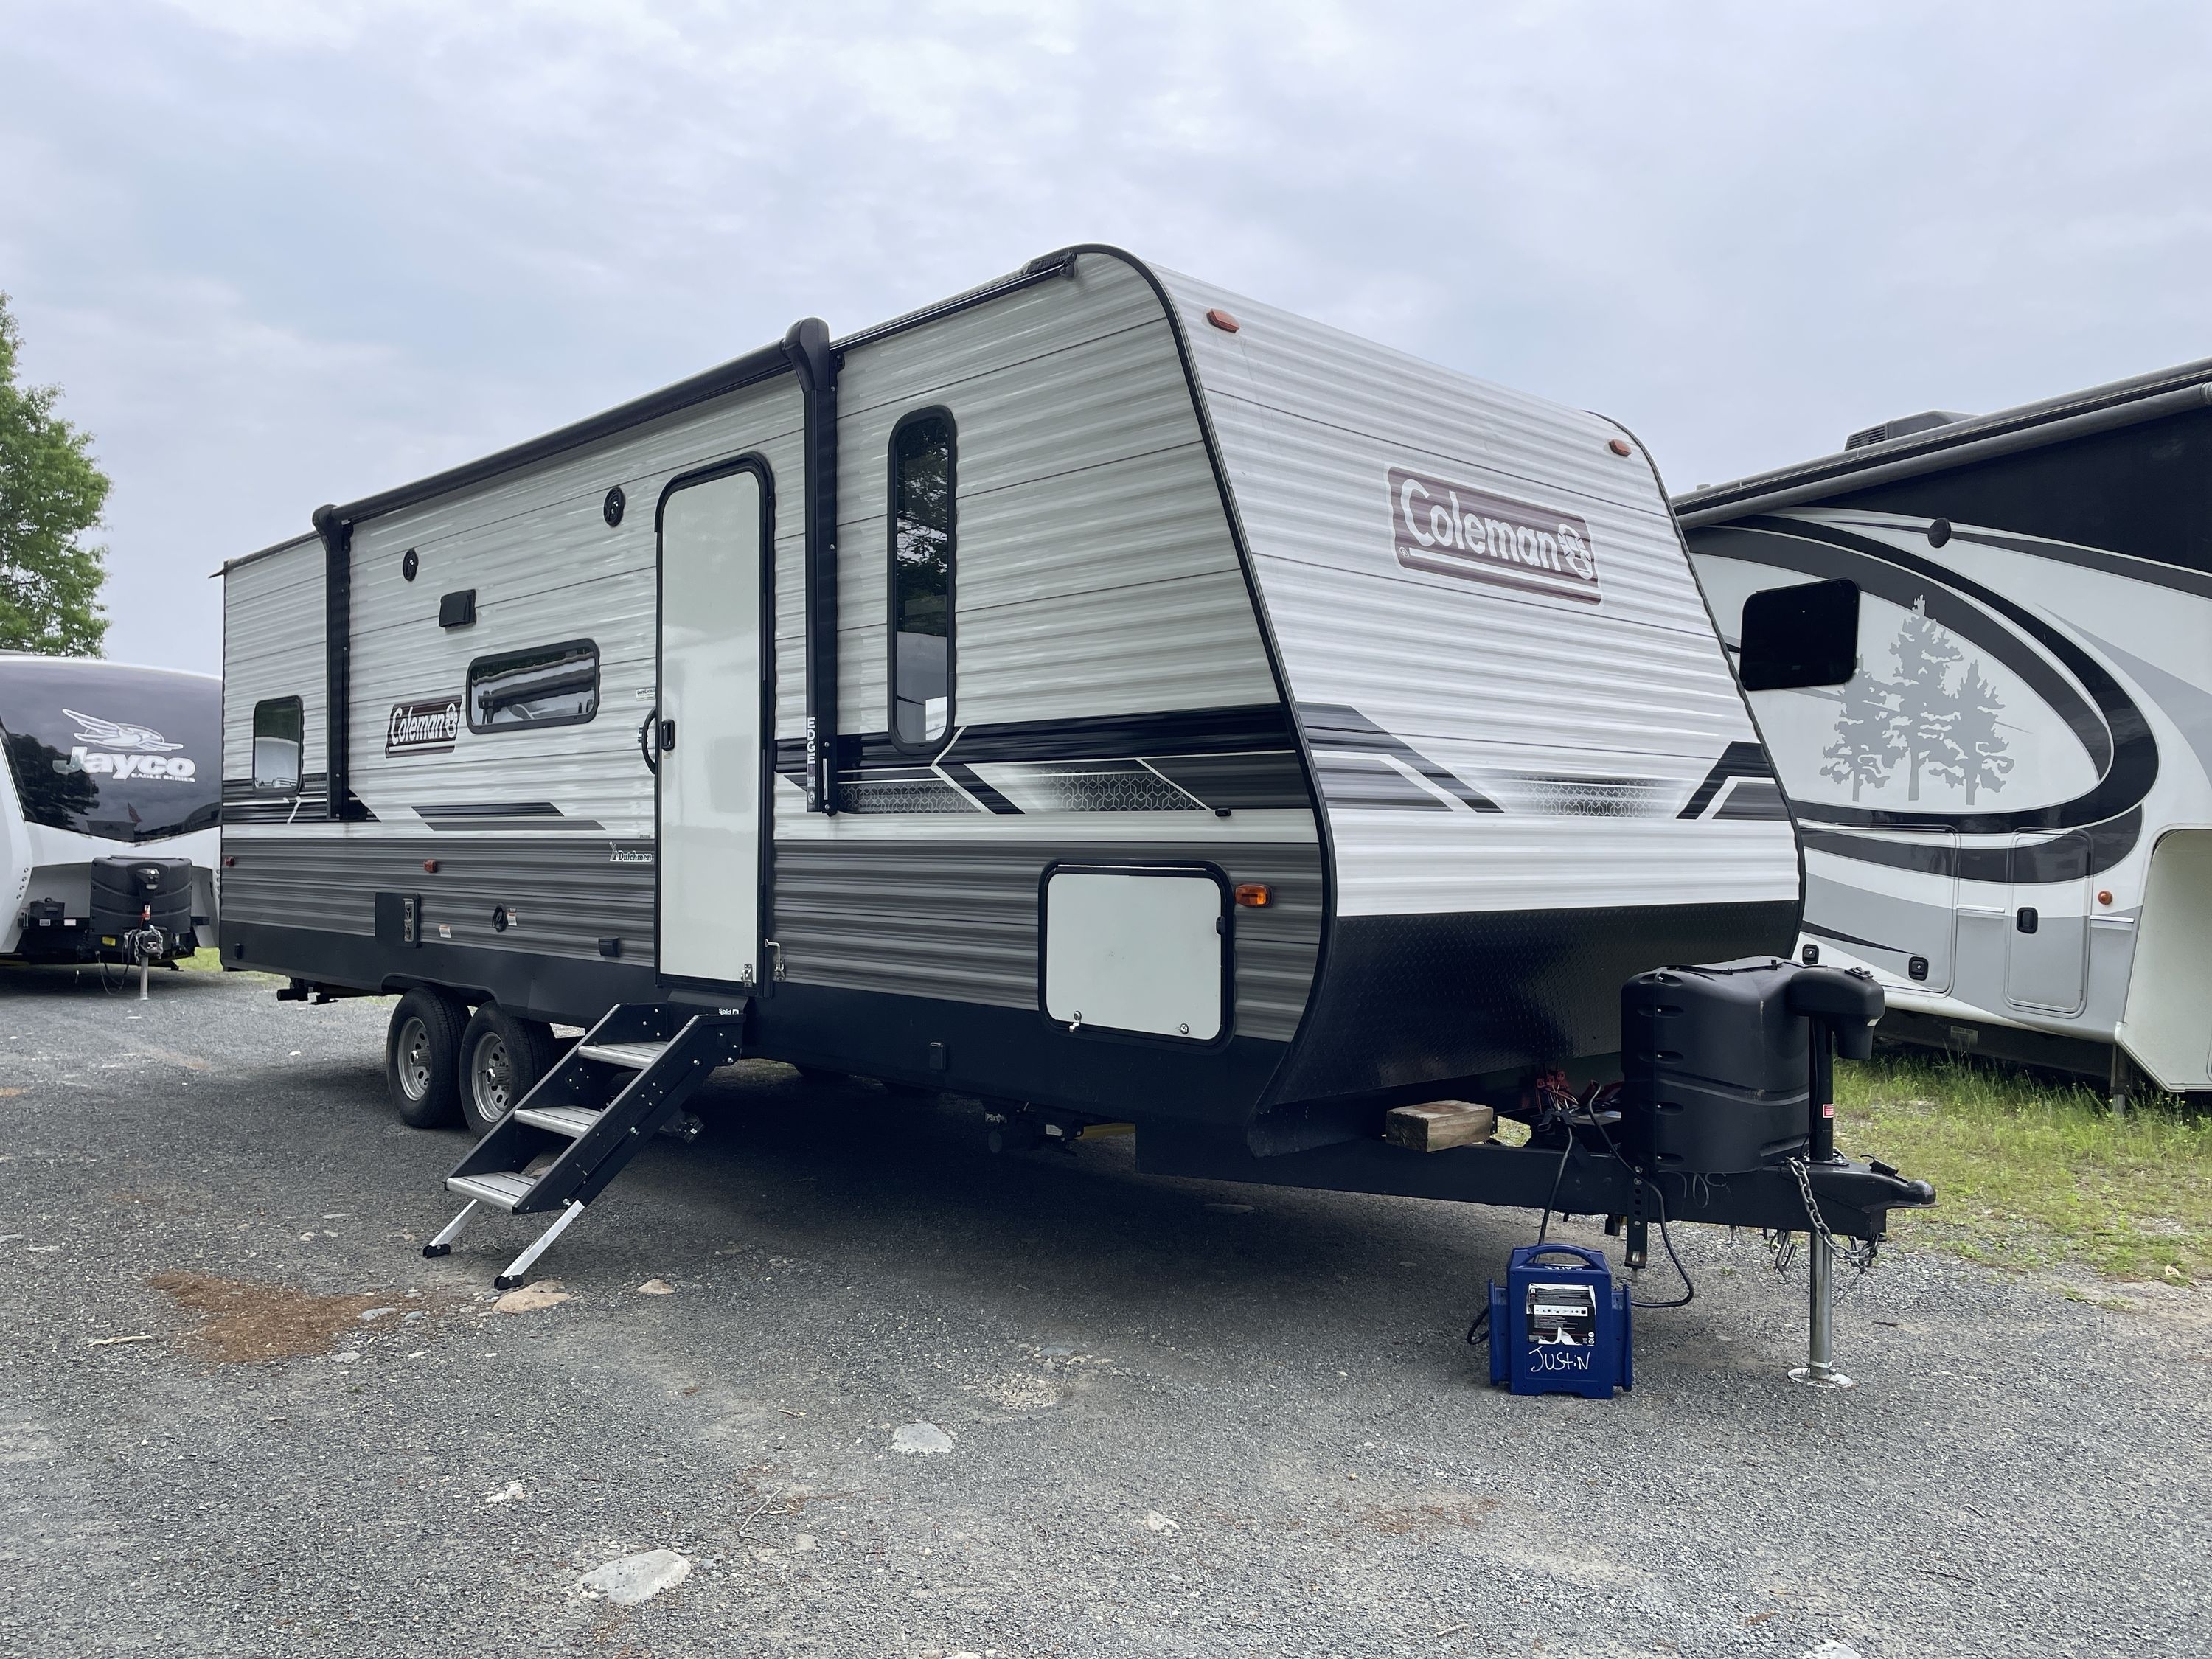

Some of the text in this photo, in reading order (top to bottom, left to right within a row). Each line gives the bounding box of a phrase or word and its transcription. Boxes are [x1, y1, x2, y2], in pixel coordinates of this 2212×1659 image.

[1401, 479, 1562, 571] Coleman
[390, 706, 445, 745] Coleman
[807, 717, 815, 764] EDGE
[52, 745, 196, 779] Jayco
[618, 850, 652, 862] Dutchmen
